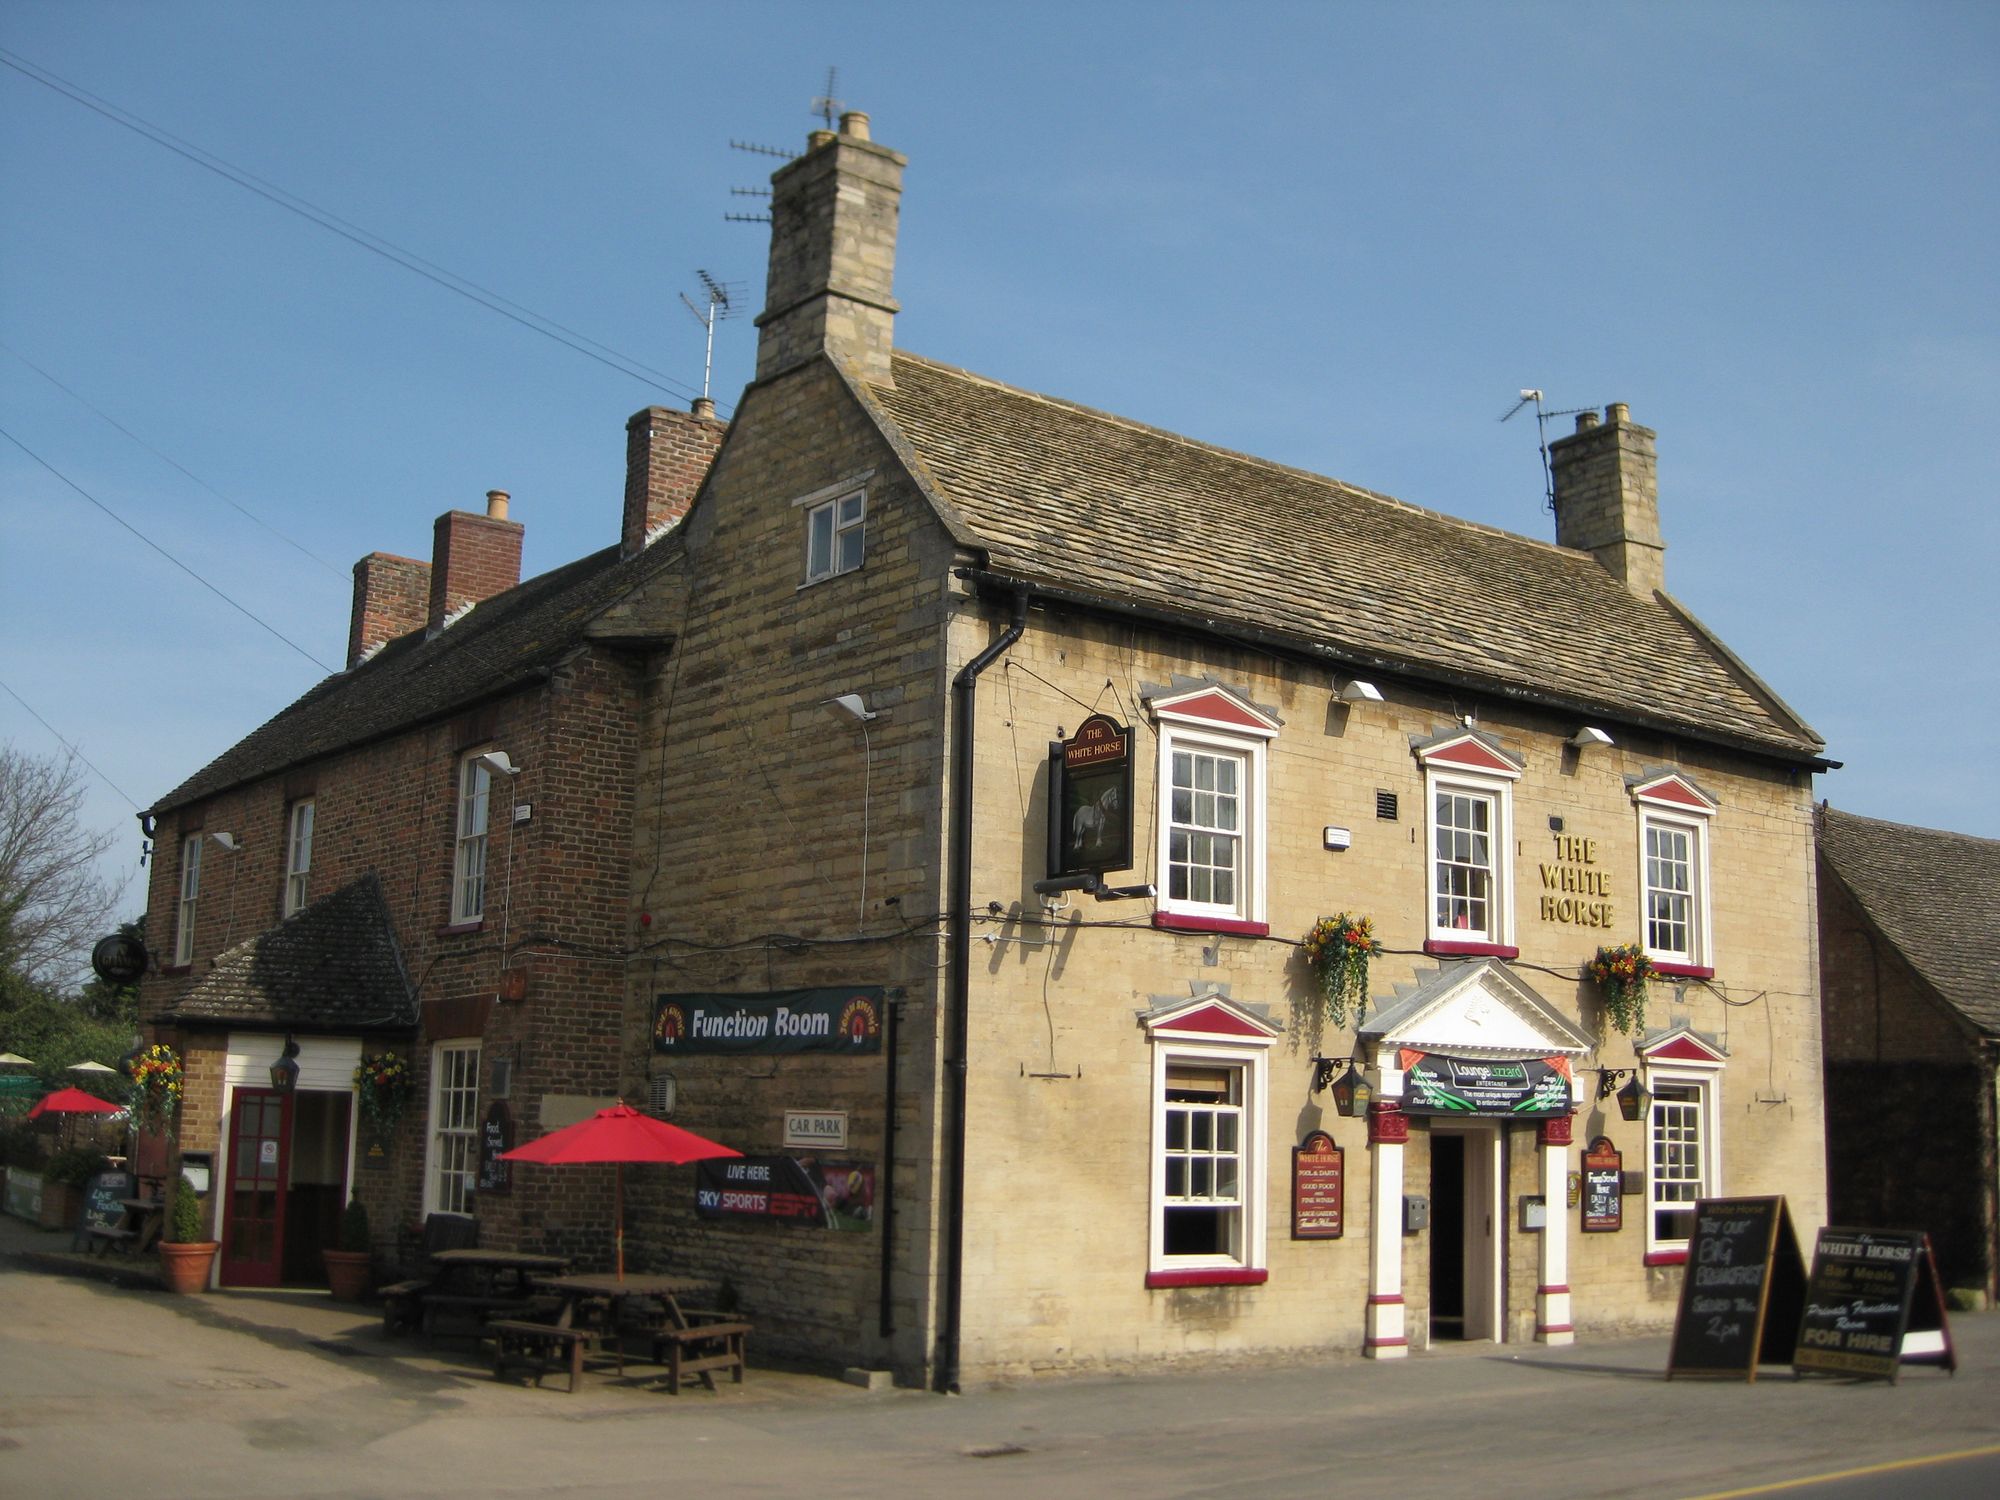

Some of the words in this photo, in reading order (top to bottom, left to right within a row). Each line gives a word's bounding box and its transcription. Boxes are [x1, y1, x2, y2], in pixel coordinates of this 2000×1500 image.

[1087, 728, 1104, 740] THE
[1068, 747, 1092, 759] WHITE
[1094, 741, 1121, 755] HORSE
[1554, 834, 1596, 864] THE
[1539, 863, 1610, 897] WHITE
[1541, 896, 1614, 928] HORSE
[692, 1009, 768, 1038] Function
[775, 1007, 829, 1036] Room
[789, 1118, 809, 1132] CAR
[815, 1119, 840, 1133] PARK
[1312, 1140, 1328, 1152] The
[1298, 1154, 1318, 1162] WHITE
[1319, 1154, 1339, 1162] HORSE
[727, 1164, 746, 1179] LIVE
[747, 1166, 770, 1181] HERE
[699, 1190, 720, 1207] SKY
[722, 1193, 767, 1211] SPORTS
[1699, 1237, 1734, 1264] BIG
[1819, 1242, 1862, 1256] WHITE
[1865, 1244, 1911, 1260] HORSE
[1824, 1264, 1849, 1277] Bar
[1853, 1267, 1895, 1281] Meals
[1807, 1304, 1848, 1317] Private
[1851, 1300, 1900, 1315] Function
[1835, 1316, 1867, 1329] Room
[1804, 1328, 1842, 1346] FOR
[1847, 1332, 1892, 1351] HIRE
